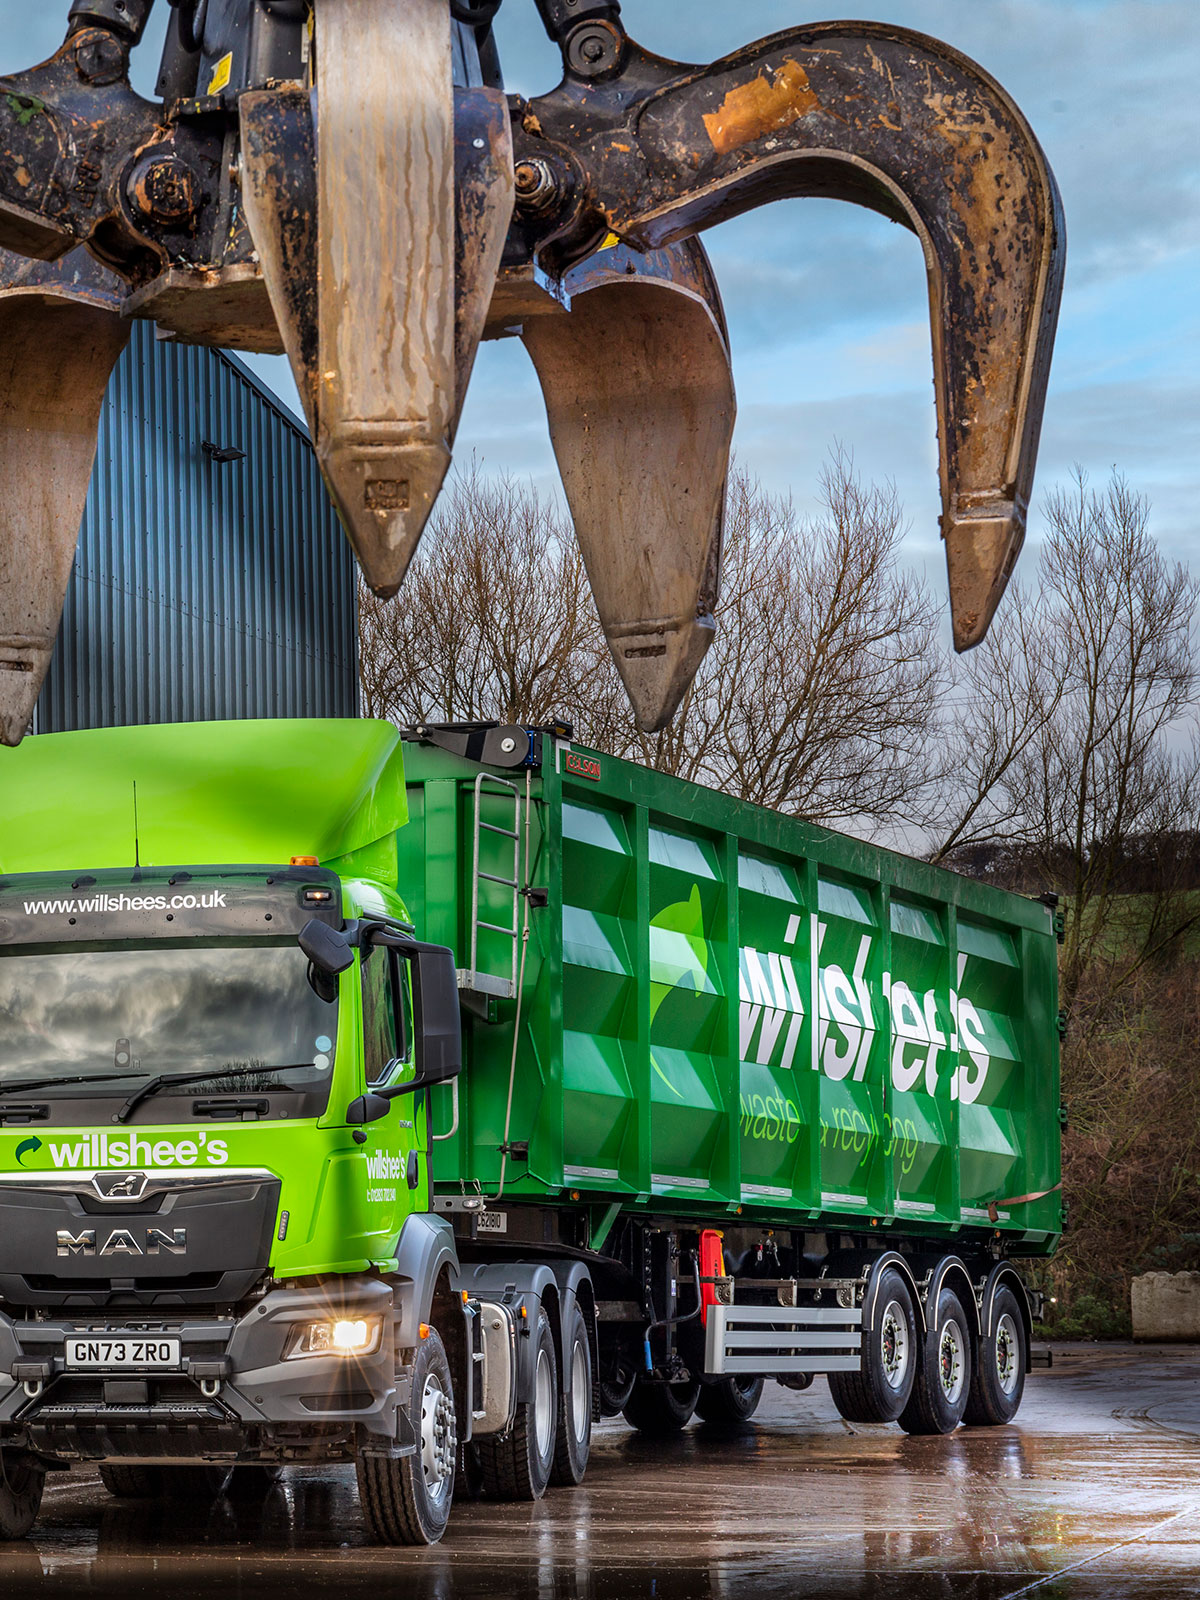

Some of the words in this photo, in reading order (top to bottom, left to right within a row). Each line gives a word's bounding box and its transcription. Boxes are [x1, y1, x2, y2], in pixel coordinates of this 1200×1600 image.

[24, 890, 227, 914] www.willshees.co.uk
[49, 1132, 228, 1167] willshee's
[367, 1149, 405, 1179] willshee's
[56, 1228, 186, 1256] MAN
[75, 1343, 126, 1361] GN73
[132, 1343, 170, 1361] ZRO
